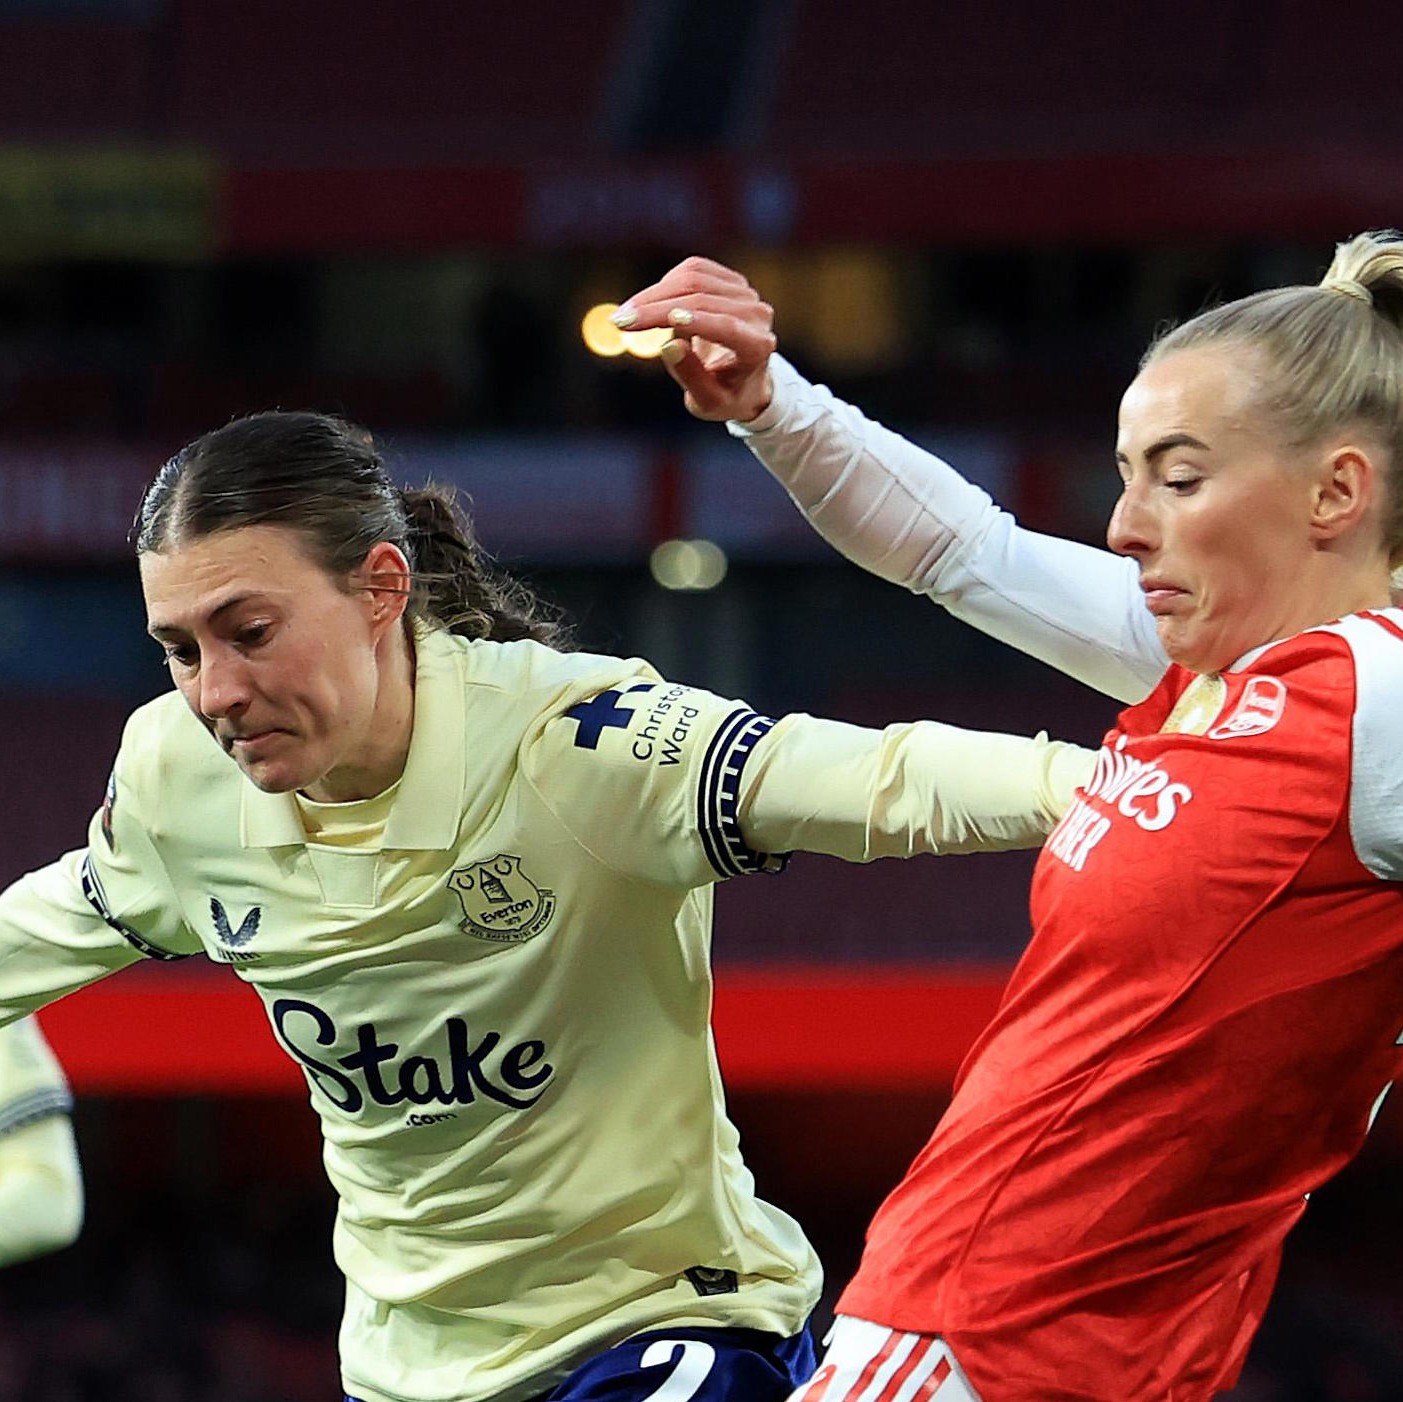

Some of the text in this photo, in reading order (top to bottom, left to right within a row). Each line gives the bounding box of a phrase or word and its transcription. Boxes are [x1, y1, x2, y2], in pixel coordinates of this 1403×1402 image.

[659, 706, 699, 766] Ward
[480, 899, 534, 924] Everton
[273, 998, 555, 1113] Stake
